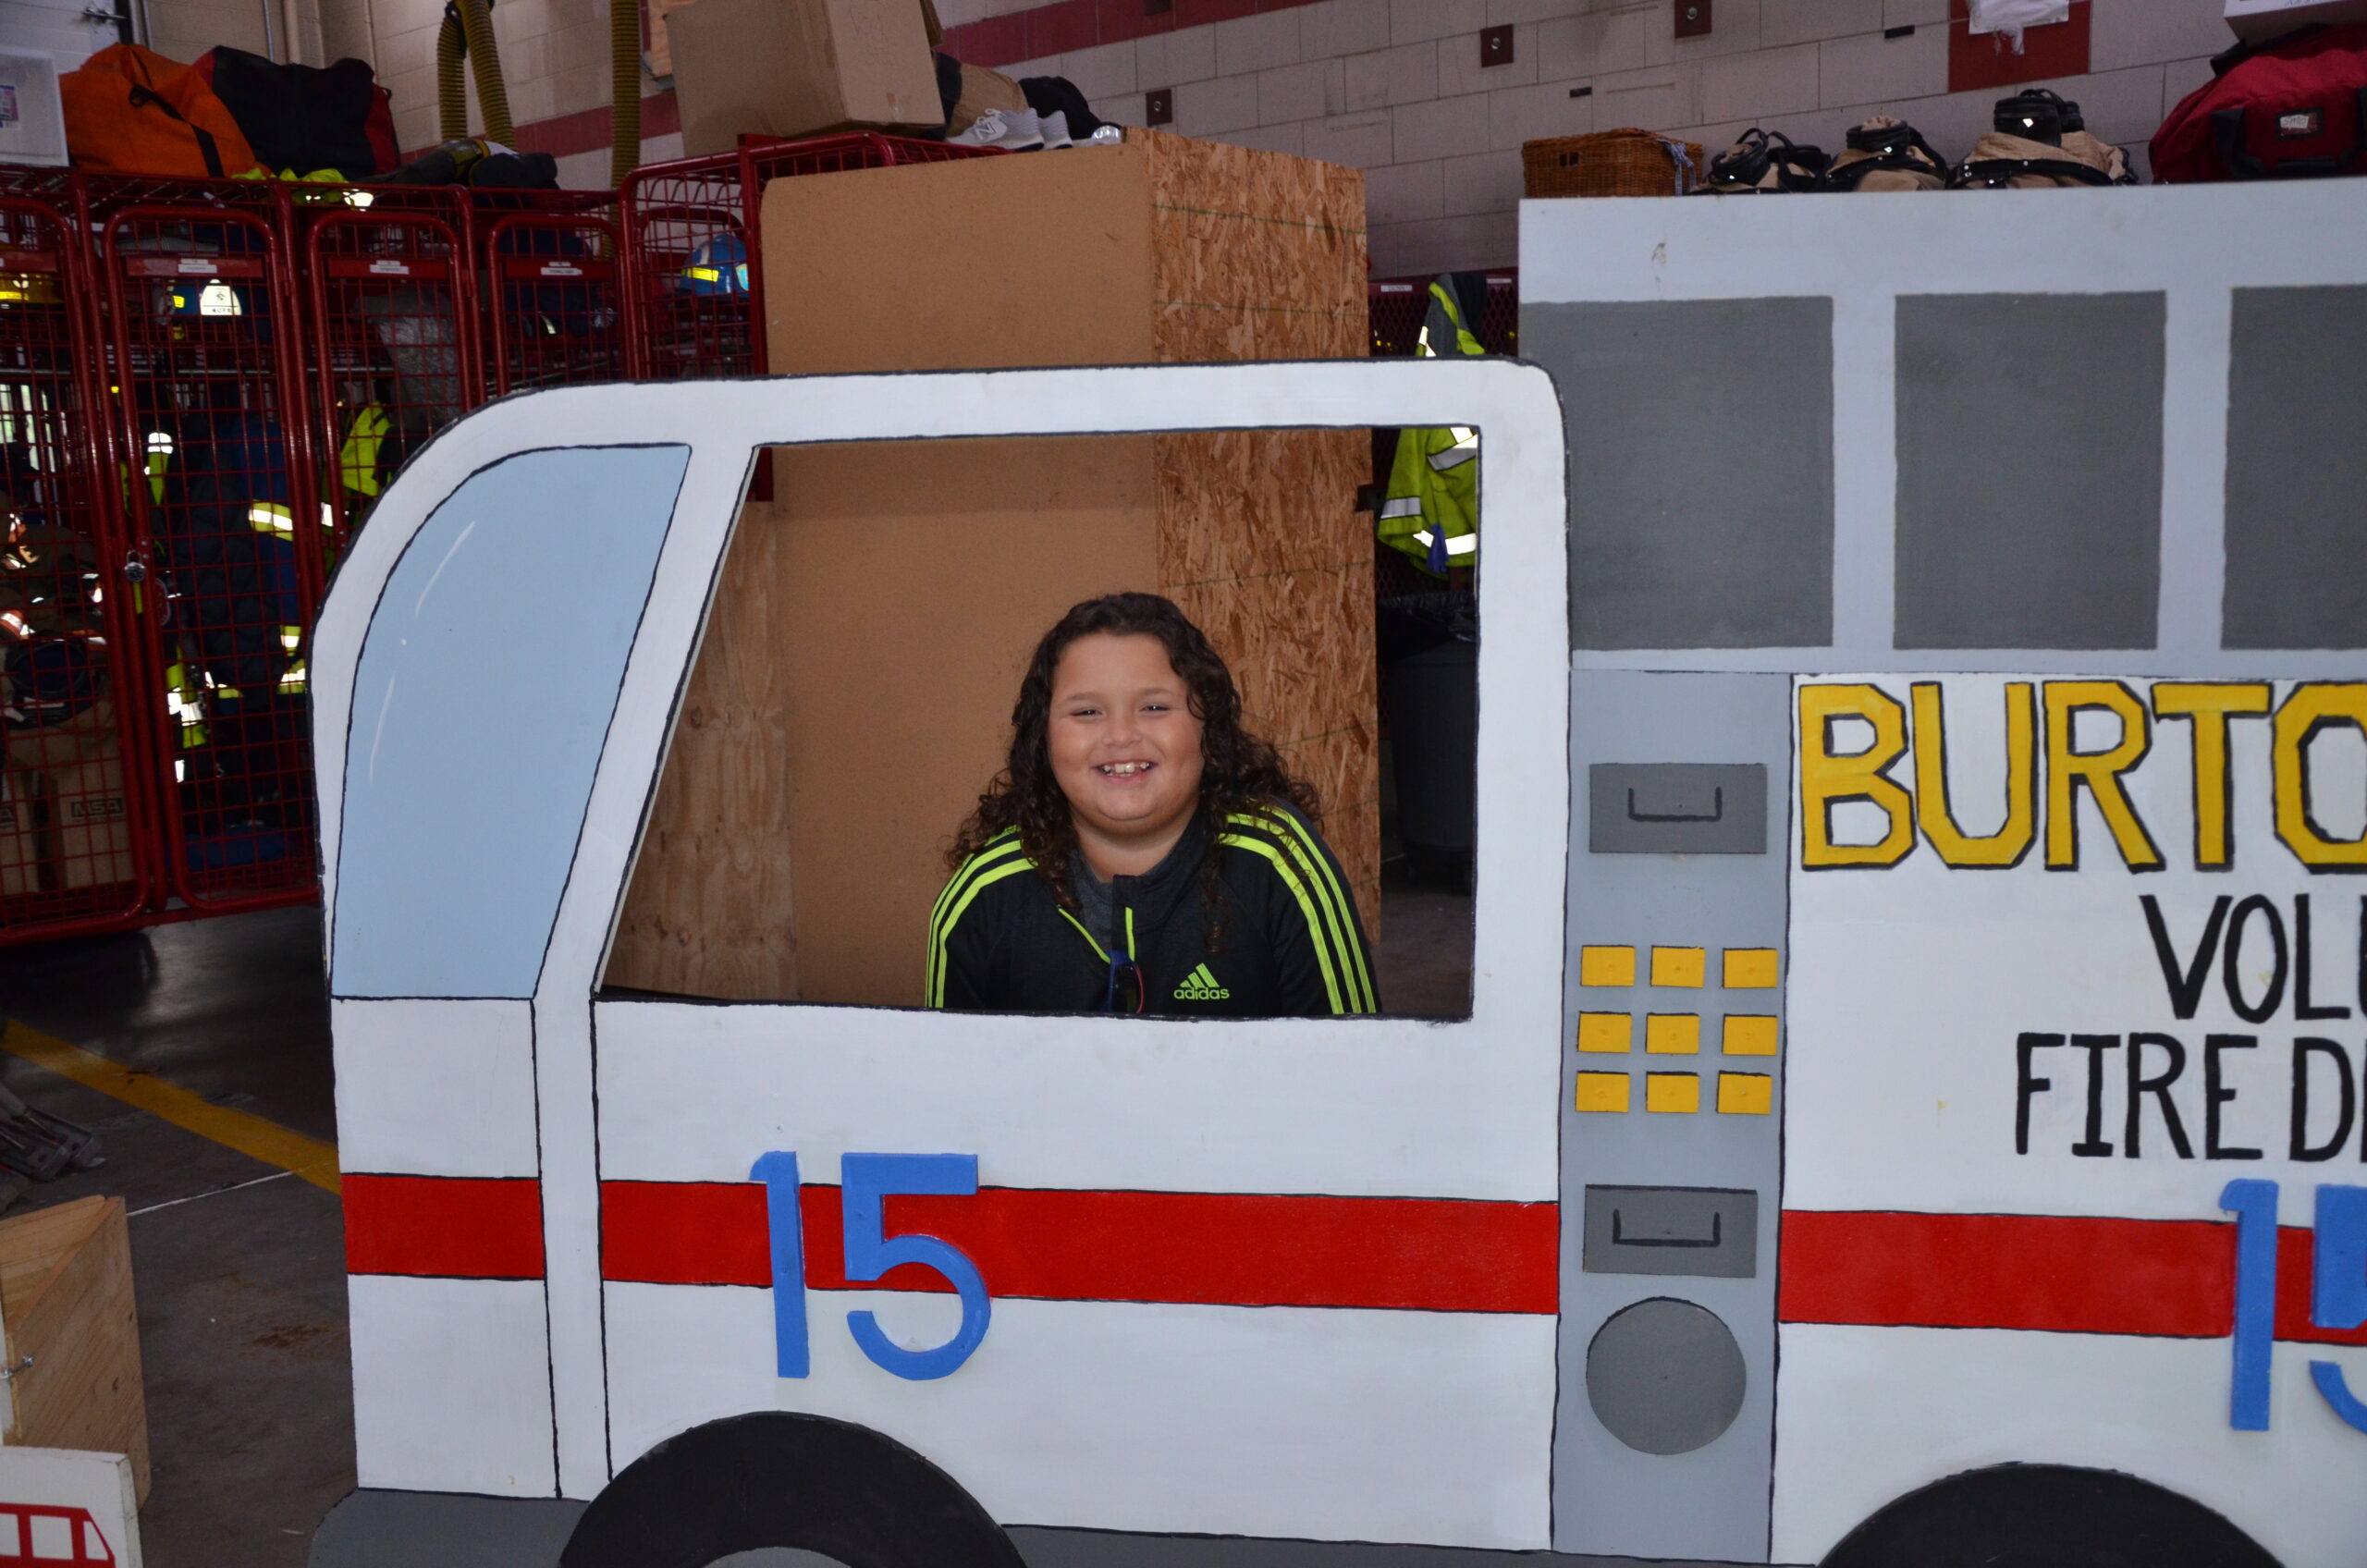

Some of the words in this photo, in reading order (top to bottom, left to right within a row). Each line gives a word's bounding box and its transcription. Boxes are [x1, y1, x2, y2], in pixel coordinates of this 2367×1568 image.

[72, 799, 123, 818] MSA
[1173, 986, 1230, 999] adidas
[2139, 893, 2367, 1023] VOL
[2016, 1033, 2263, 1161] FIRE
[2289, 1036, 2367, 1164] D
[748, 1151, 992, 1381] 15
